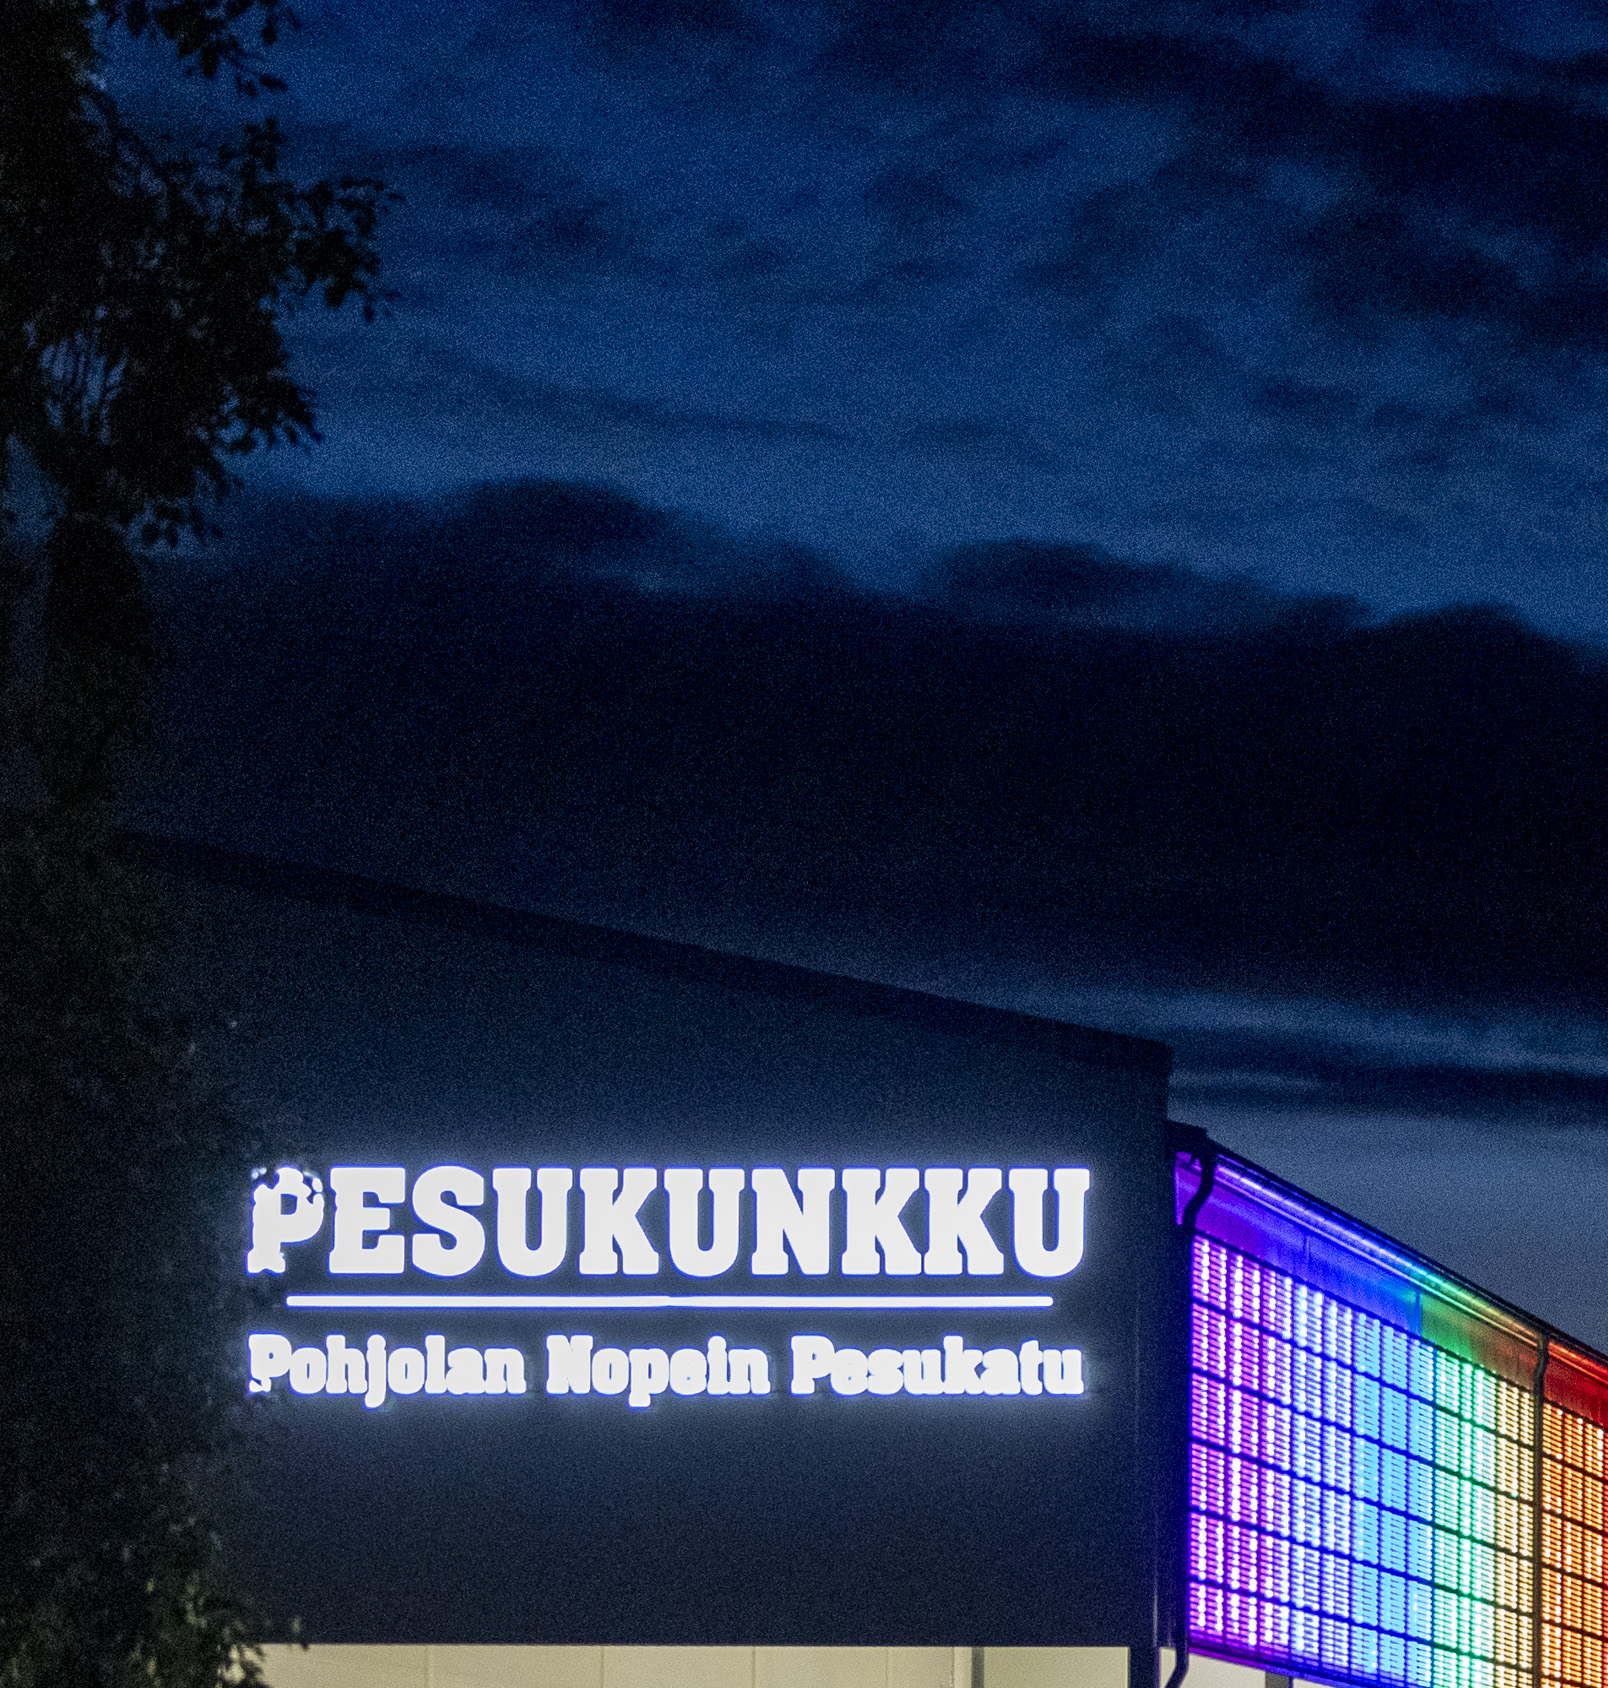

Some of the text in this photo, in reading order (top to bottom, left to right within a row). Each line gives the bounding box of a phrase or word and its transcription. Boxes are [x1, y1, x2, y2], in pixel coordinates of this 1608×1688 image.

[247, 1165, 1090, 1277] PESUKUNKKU
[248, 1334, 1085, 1408] Pohjolan Nopein Pesukatu
